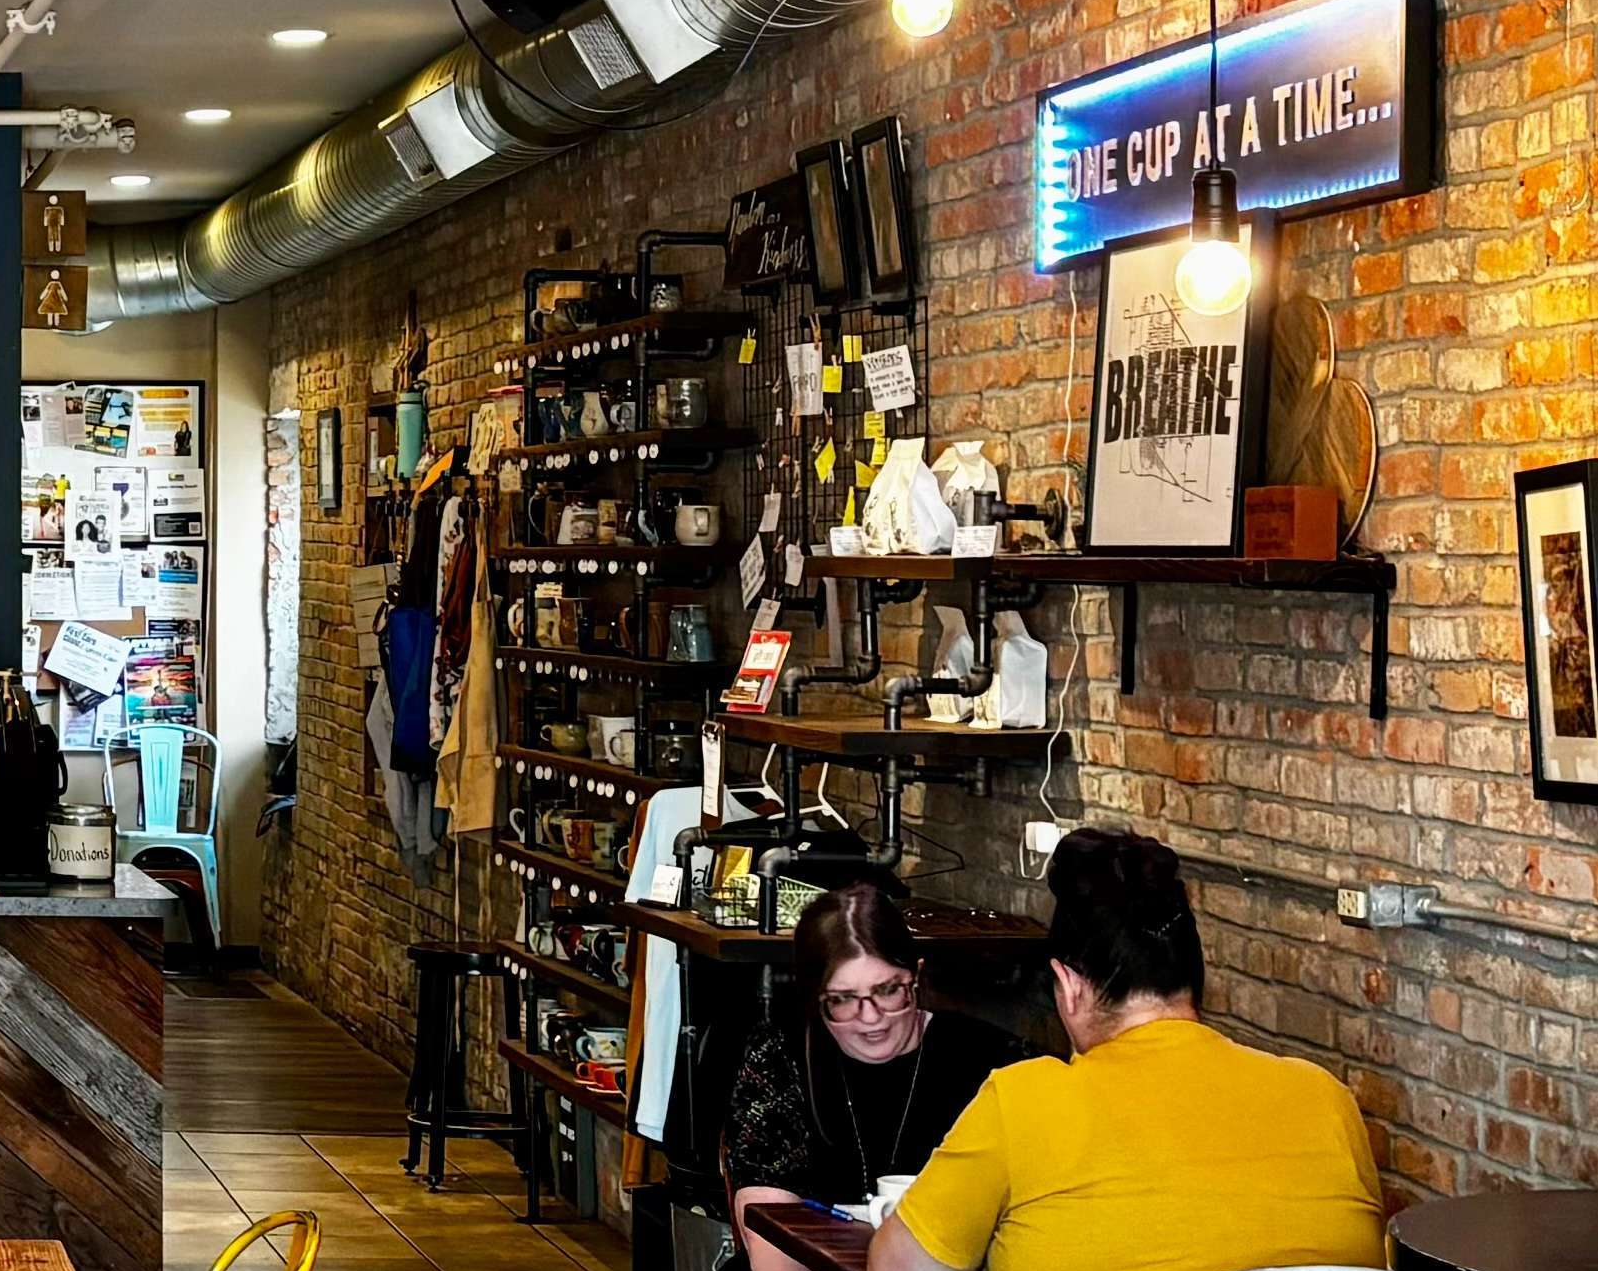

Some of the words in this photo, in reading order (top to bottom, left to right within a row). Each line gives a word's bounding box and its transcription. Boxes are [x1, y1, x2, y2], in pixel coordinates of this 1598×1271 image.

[1066, 137, 1118, 205] ONE
[1125, 120, 1182, 189] CUP
[1191, 105, 1233, 169] AT
[1238, 95, 1263, 158] A
[1272, 64, 1393, 148] TIME...
[1102, 344, 1237, 445] BREATHE
[49, 830, 110, 863] Donations
